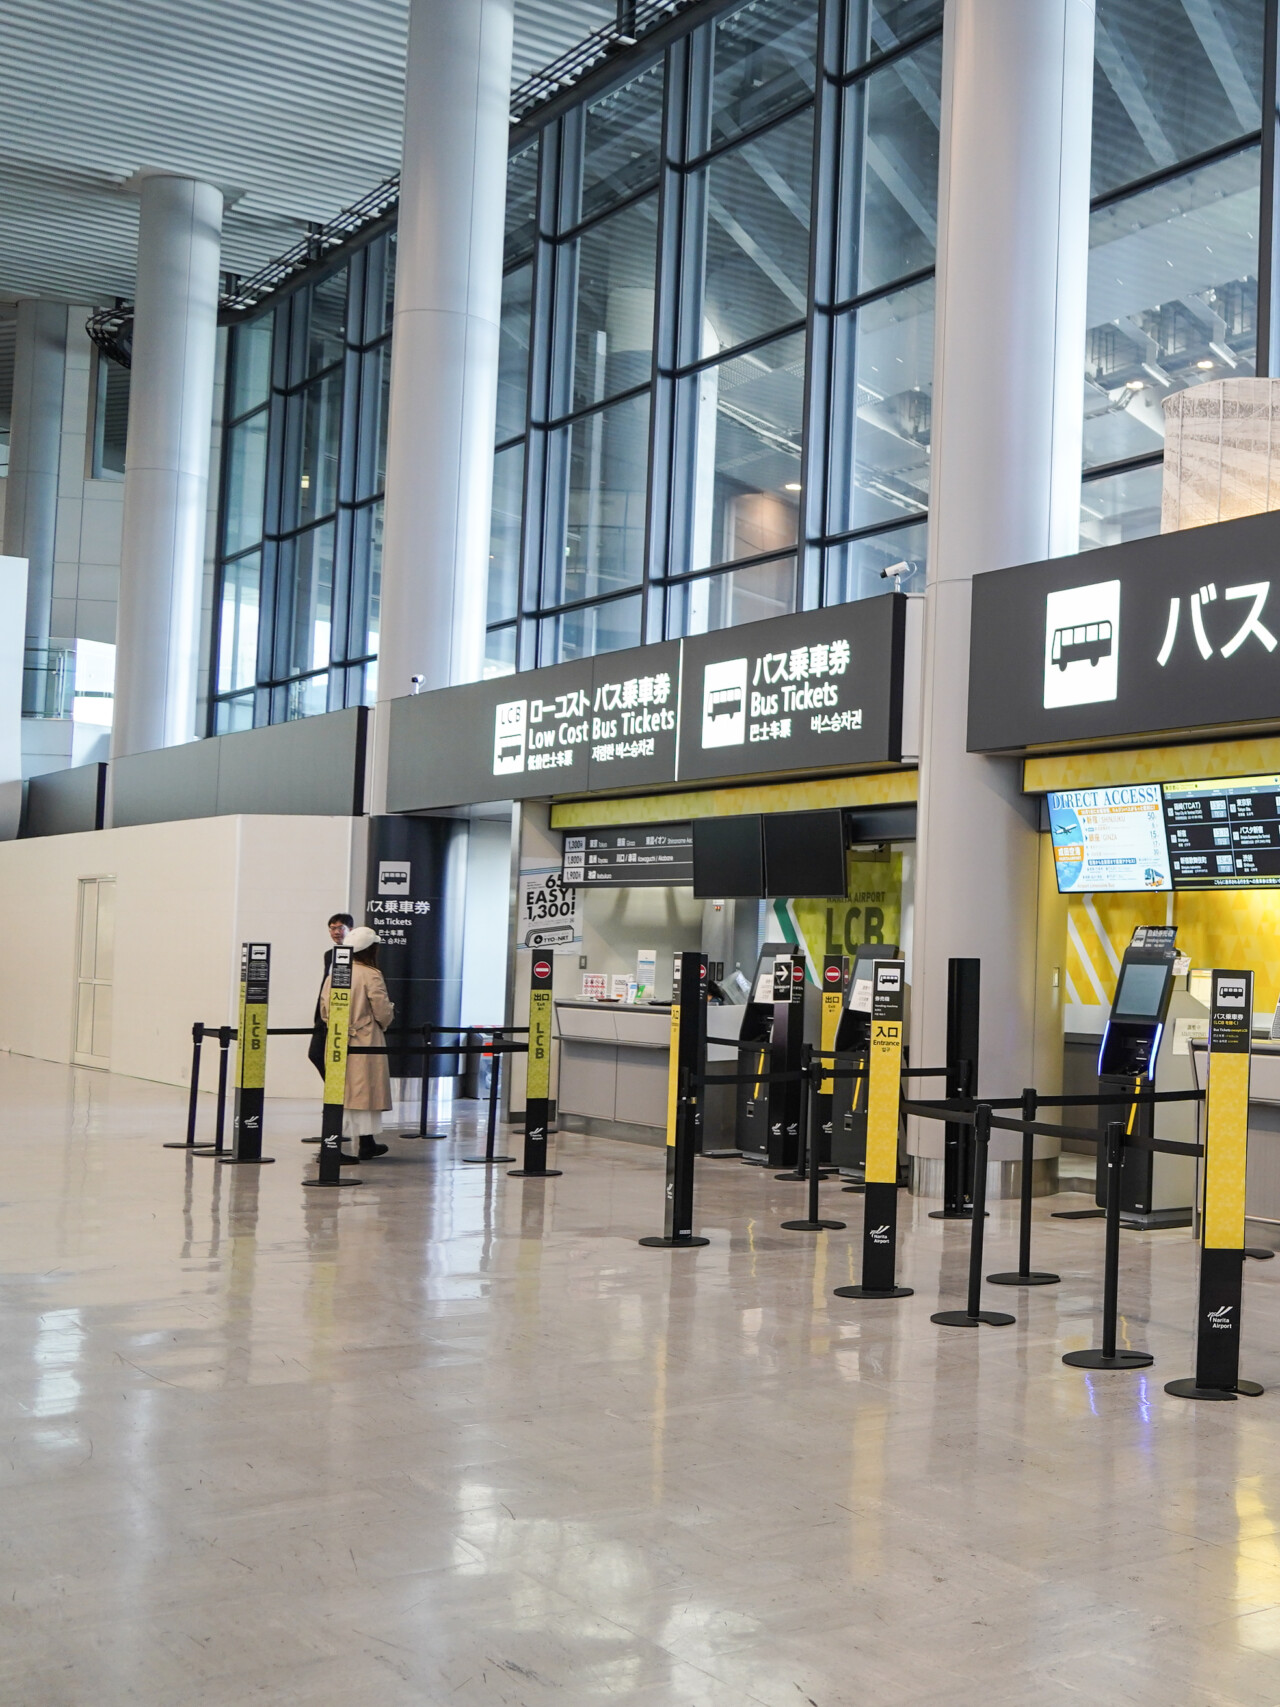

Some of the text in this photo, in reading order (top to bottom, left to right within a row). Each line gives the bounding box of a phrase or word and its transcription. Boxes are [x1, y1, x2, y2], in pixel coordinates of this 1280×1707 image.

[753, 639, 851, 686] バス乗車券
[530, 673, 671, 723] ローコスト バス乗車券
[750, 681, 838, 717] Bus Tickets
[501, 706, 521, 724] LCB
[810, 708, 862, 734] 버스승차권
[528, 708, 675, 749] Low Cost Bus Tickets
[749, 718, 792, 742] 巴士车票
[1052, 791, 1099, 810] DIRECT
[1103, 786, 1159, 806] ACCESS!
[366, 900, 431, 914] バス乗車券
[526, 888, 576, 906] EASY!
[854, 892, 886, 903] AIRPORT
[386, 918, 412, 926] Tickets
[526, 902, 576, 922] 1,300!
[826, 906, 884, 956] LCB
[333, 992, 348, 1001] 入口
[534, 993, 550, 1001] 出口
[252, 1014, 260, 1050] LCB
[333, 1024, 342, 1062] LCB
[535, 1022, 544, 1059] LCB
[876, 1026, 898, 1038] 入口
